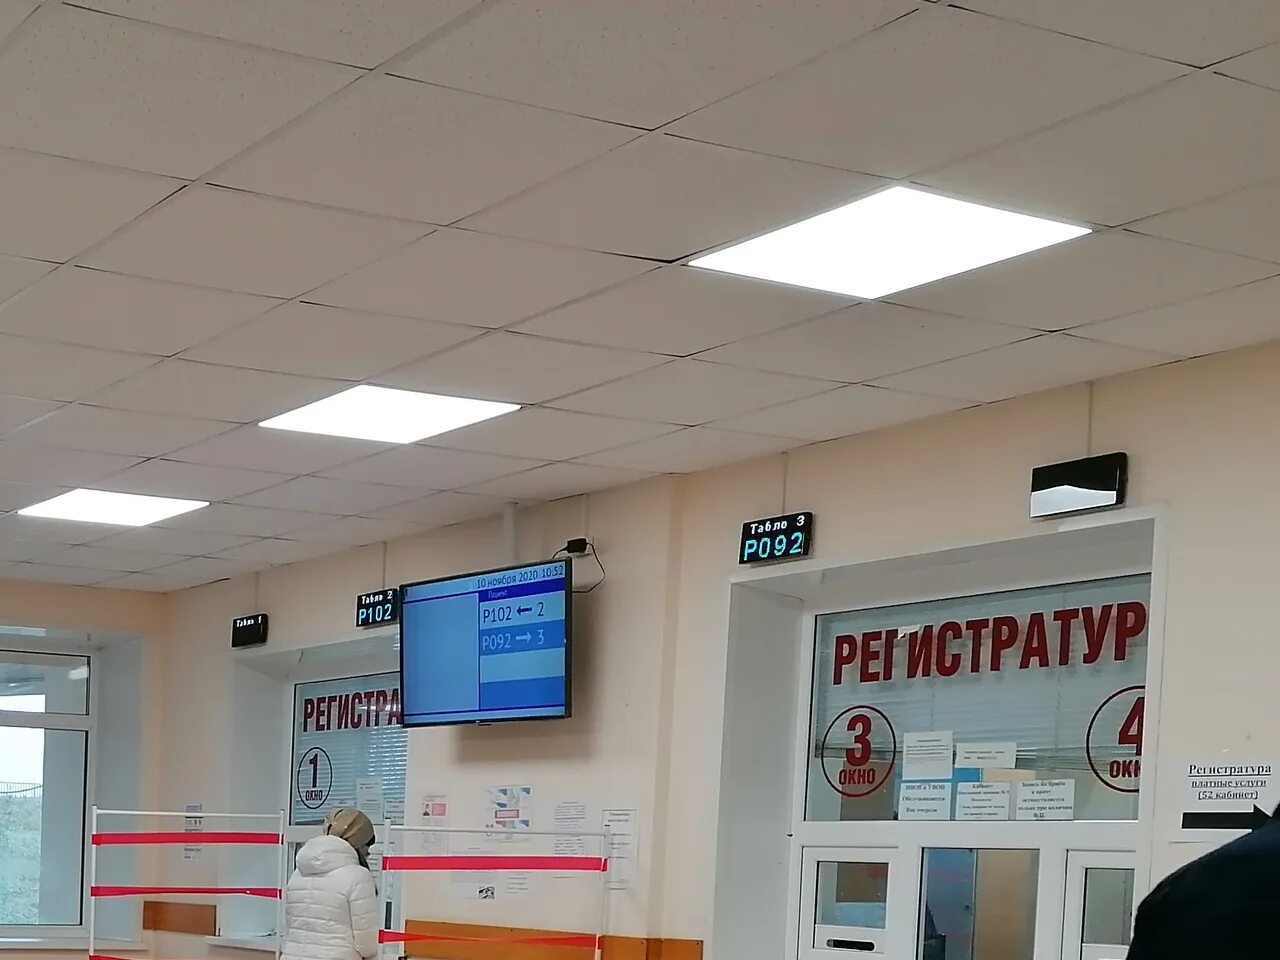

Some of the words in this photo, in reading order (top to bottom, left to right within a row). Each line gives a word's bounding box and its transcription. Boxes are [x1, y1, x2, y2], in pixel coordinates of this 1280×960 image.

[750, 520, 787, 534] Табло
[796, 515, 805, 526] 3
[477, 578, 486, 589] 10
[488, 575, 517, 587] ноября
[519, 570, 539, 582] 2020
[542, 565, 564, 579] 10:52
[361, 594, 383, 605] Табло
[387, 591, 393, 599] 2
[537, 602, 544, 617] 2
[258, 616, 262, 624] 1
[537, 629, 544, 645] 3
[303, 688, 402, 732] РЕГИСТРА
[1118, 697, 1145, 756] 4
[846, 714, 872, 766] 3
[309, 753, 318, 788] 1
[838, 769, 876, 785] ОКНО
[1188, 765, 1272, 776] Регистратура
[1191, 780, 1233, 788] платные
[1234, 780, 1267, 788] услуги
[305, 790, 324, 801] ОКНО
[1198, 790, 1213, 800] (52
[1215, 790, 1259, 800] кабинет)
